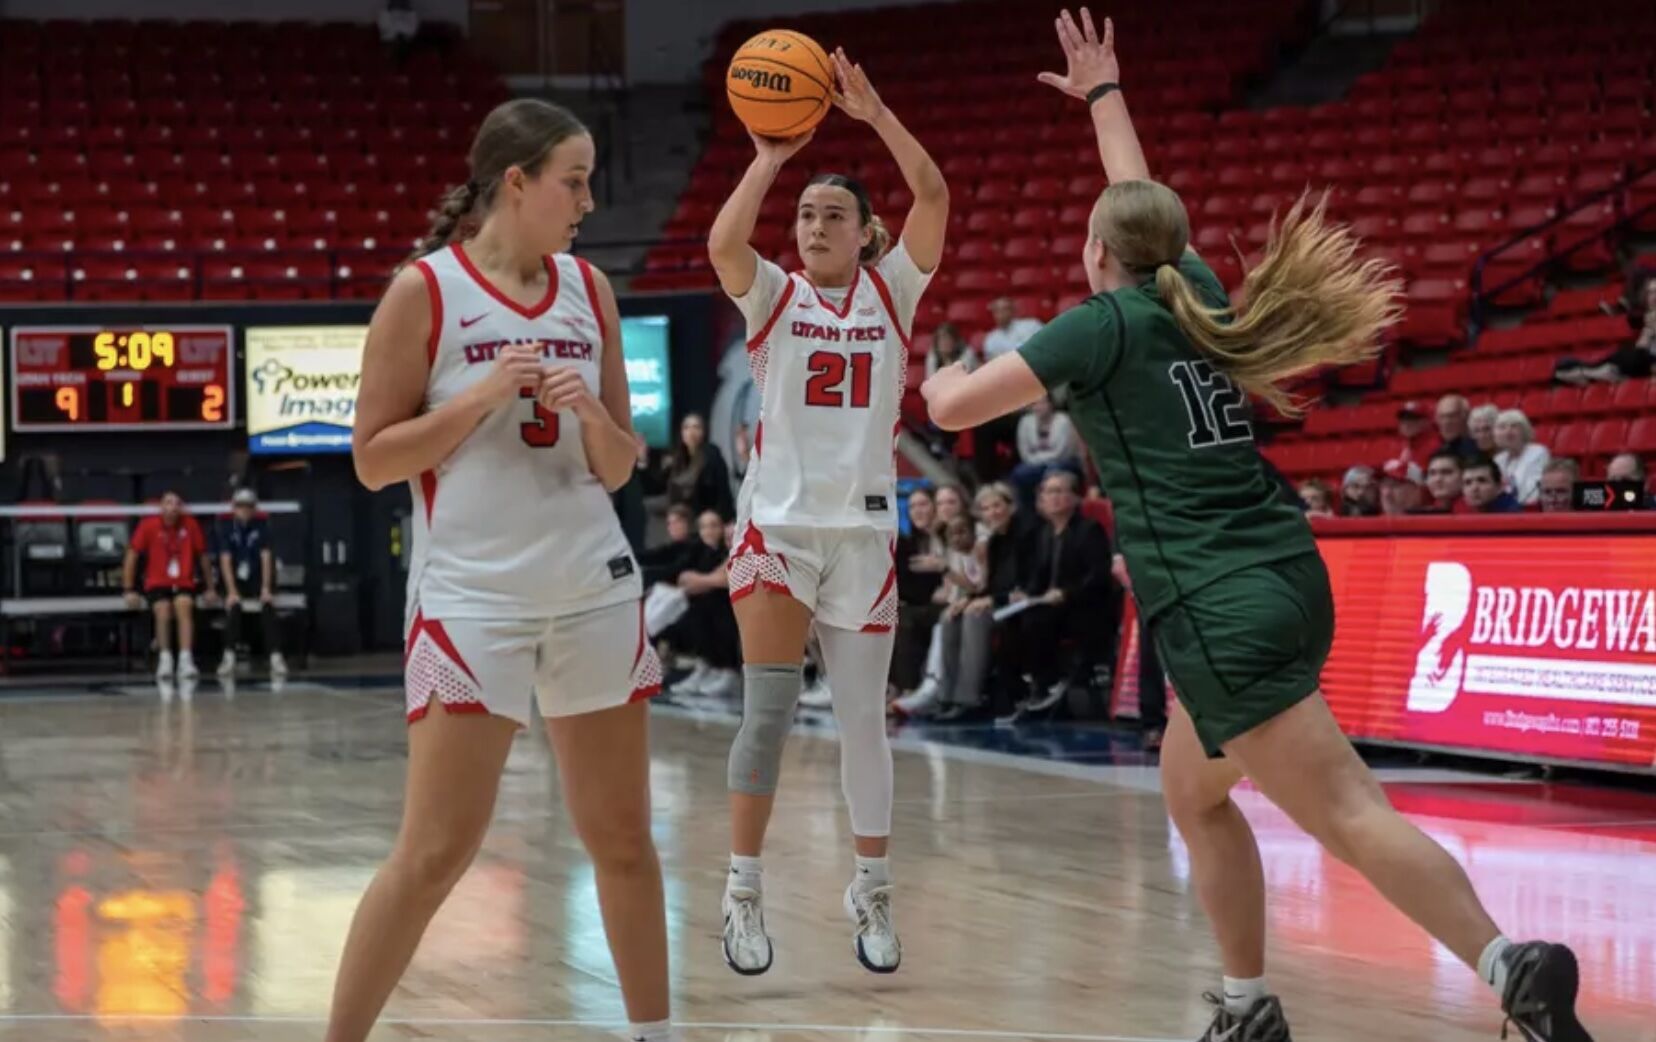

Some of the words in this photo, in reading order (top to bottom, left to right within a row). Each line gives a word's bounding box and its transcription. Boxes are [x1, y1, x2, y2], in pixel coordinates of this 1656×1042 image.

[731, 67, 791, 93] Wilson
[791, 320, 841, 341] UTAH
[842, 325, 886, 341] TECH
[94, 332, 174, 370] 5:09
[463, 339, 535, 364] UT
[537, 339, 593, 361] TECH
[122, 382, 134, 407] 1
[804, 350, 873, 408] 21
[55, 387, 78, 420] 9
[202, 385, 224, 421] 2
[279, 394, 355, 419] Imag
[518, 386, 559, 448] 3
[1168, 360, 1253, 449] 12
[1469, 586, 1656, 653] BRIDGEWA
